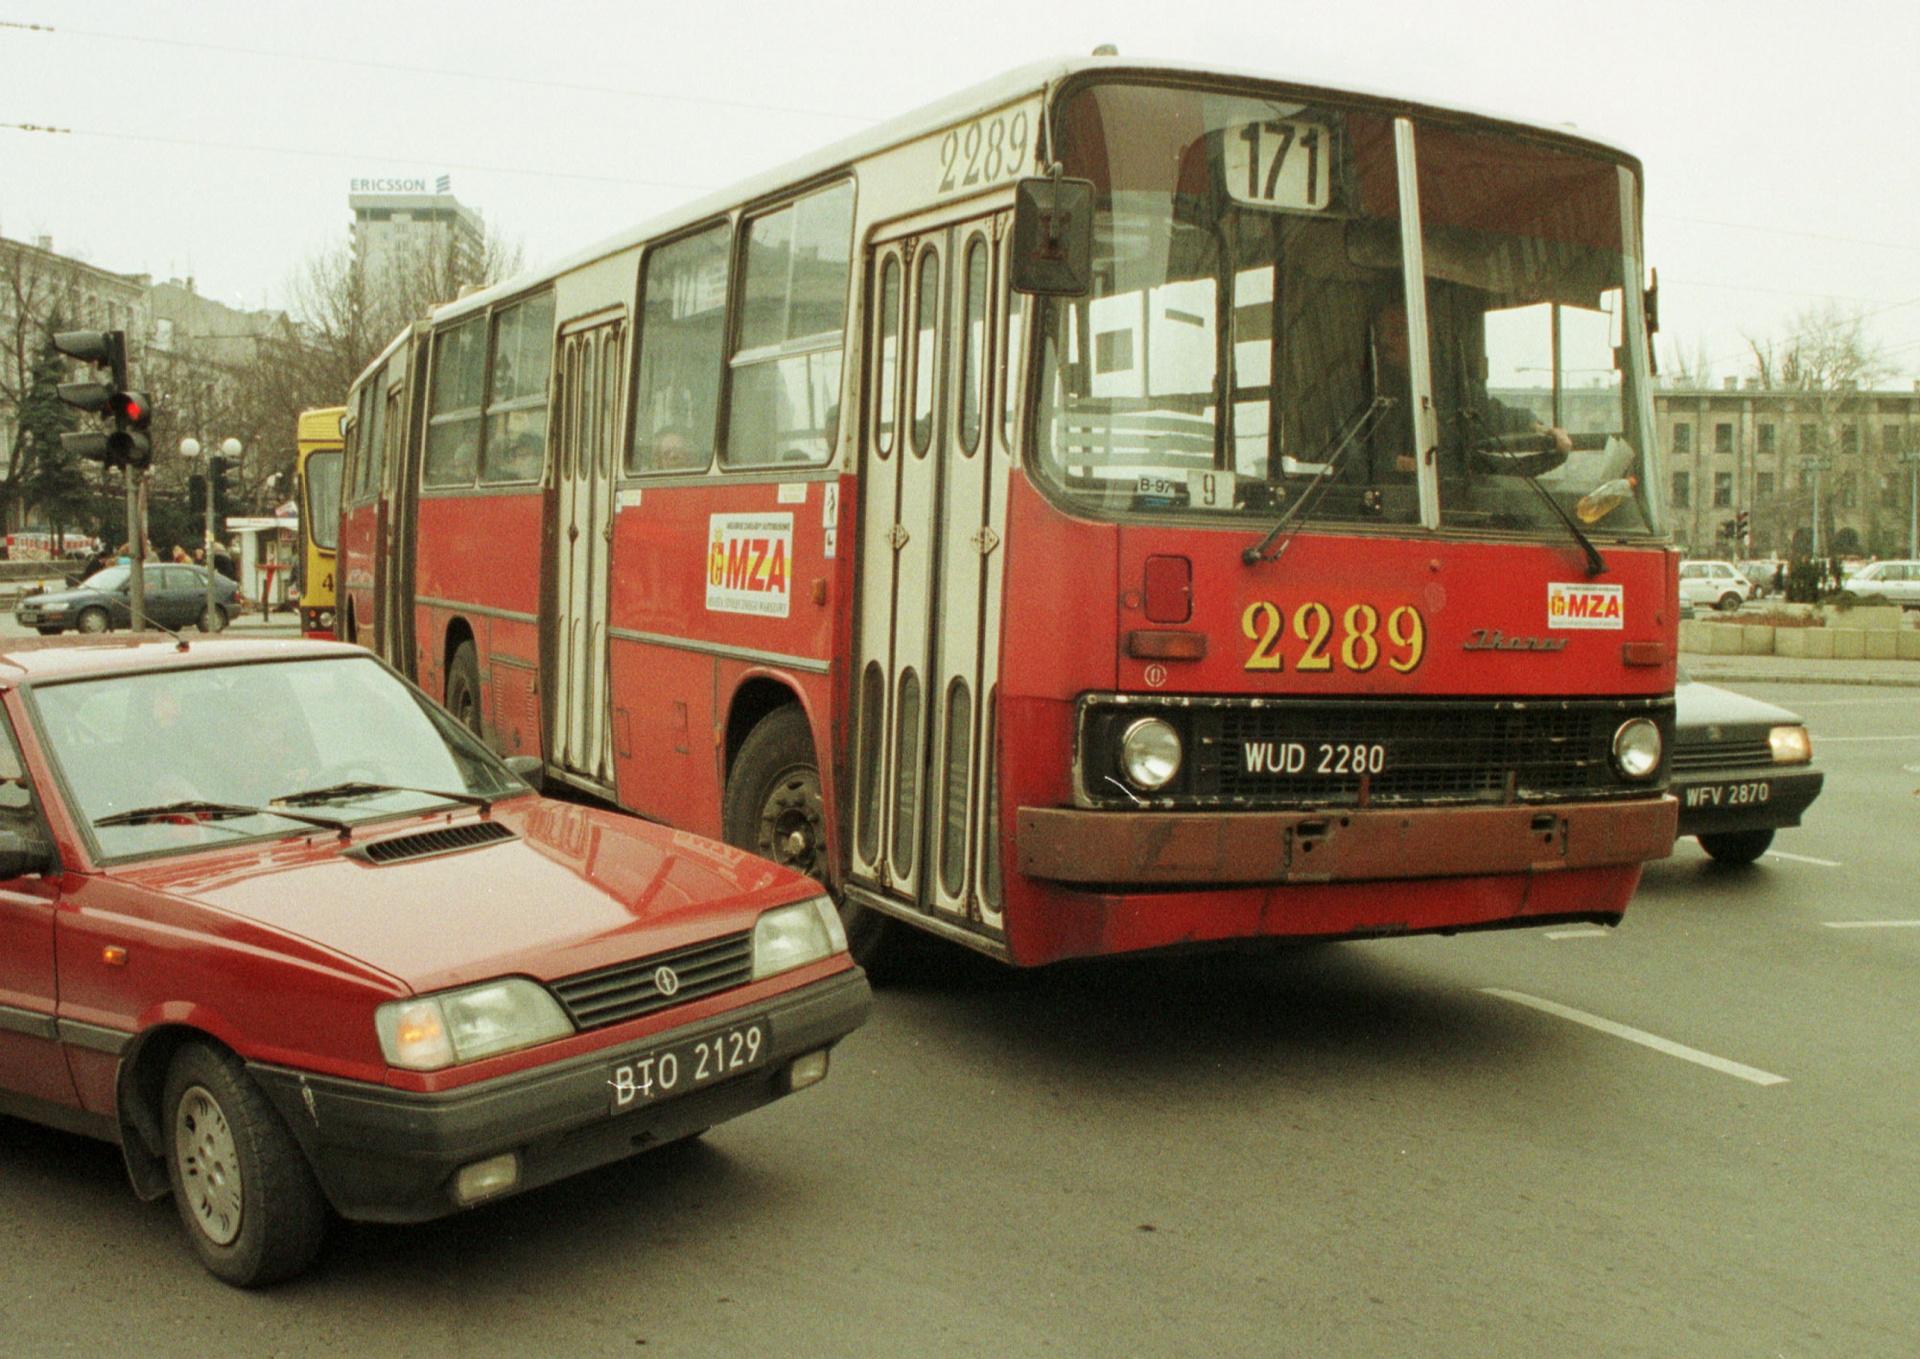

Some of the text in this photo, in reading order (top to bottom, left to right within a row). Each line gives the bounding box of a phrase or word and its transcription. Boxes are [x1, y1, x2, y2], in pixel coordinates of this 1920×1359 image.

[939, 110, 1028, 193] 2289
[1240, 121, 1318, 206] 171
[351, 177, 425, 191] ERICSSON
[726, 538, 786, 593] MZA
[1568, 594, 1620, 618] MZA
[1242, 601, 1426, 673] 2289
[1245, 743, 1385, 774] WUD 2280
[1686, 783, 1769, 807] WFV 2870
[616, 1026, 762, 1105] BTO 2129
